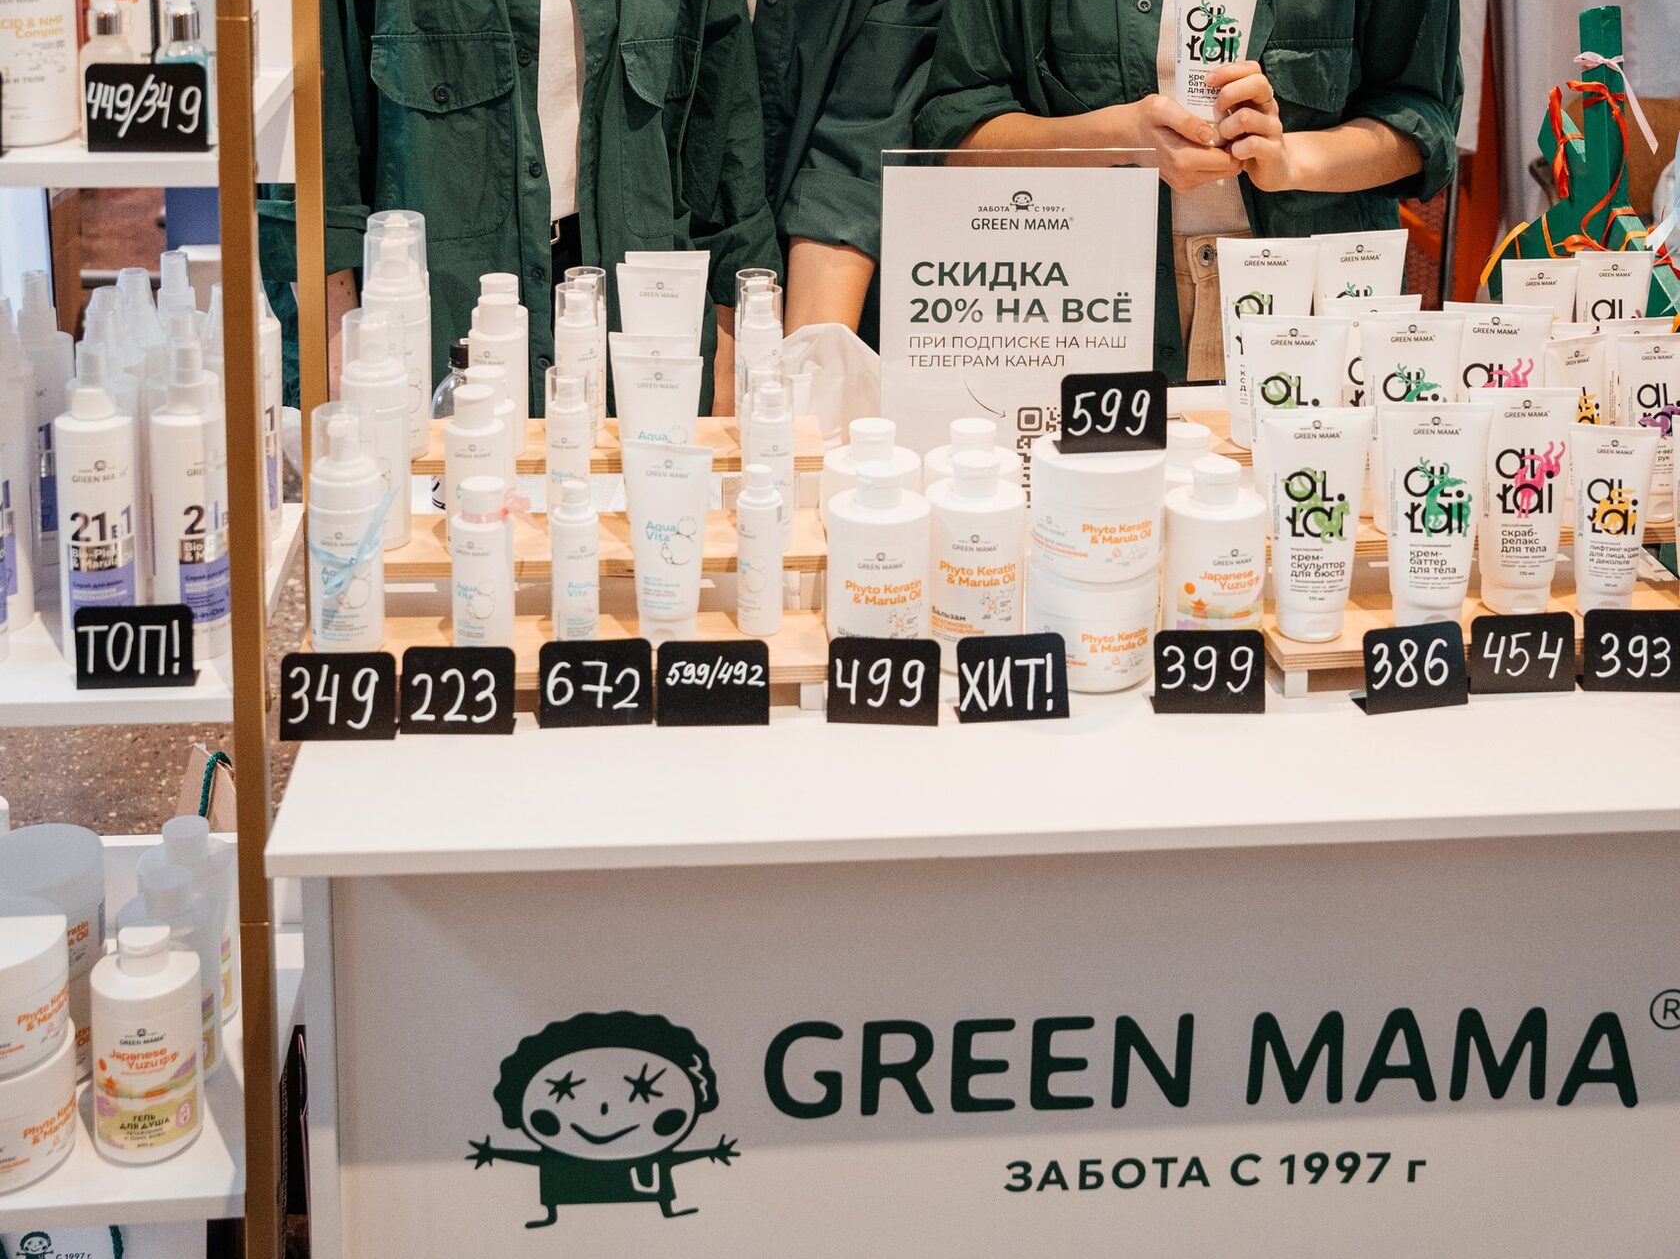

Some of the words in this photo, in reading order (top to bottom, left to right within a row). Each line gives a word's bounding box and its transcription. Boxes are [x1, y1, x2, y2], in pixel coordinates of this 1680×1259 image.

[971, 218, 1019, 230] GREEN
[1024, 218, 1070, 230] MAMA
[1244, 259, 1266, 267] GREEN
[911, 261, 1069, 291] СКИДКА
[910, 298, 983, 323] 20%
[996, 298, 1049, 323] НА
[1062, 291, 1132, 323] ВСЁ
[909, 336, 946, 349] ПРИ
[952, 336, 1050, 351] ПОДПИСКЕ
[1056, 336, 1080, 349] НА
[1085, 335, 1127, 349] НАШ
[1271, 338, 1293, 346] GREEN
[1294, 339, 1316, 347] MAMA
[908, 354, 999, 368] ТЕЛЕГРАМ
[1005, 354, 1066, 368] КАНАЛ
[1068, 388, 1151, 437] 599
[1505, 411, 1527, 419] GREEN
[1527, 410, 1549, 418] MAMA
[1294, 432, 1317, 440] GREEN
[1318, 432, 1341, 440] MAMA
[1413, 428, 1435, 436] GREEN
[1436, 428, 1460, 436] MAMA
[70, 511, 107, 542] 21
[646, 520, 676, 532] Aqua
[1082, 523, 1117, 536] Phyto
[1118, 519, 1153, 534] Keratin
[645, 530, 670, 542] Vita
[1090, 534, 1099, 544] &
[1101, 532, 1138, 544] Marula
[1501, 537, 1539, 546] релакс
[1290, 553, 1324, 561] крем-
[1409, 550, 1443, 558] крем-
[1409, 557, 1447, 566] баттер
[939, 560, 974, 577] Phyto
[977, 561, 1016, 577] Keratin
[1290, 561, 1346, 571] скульптор
[1290, 570, 1311, 578] для
[1314, 569, 1345, 578] бюста
[1409, 566, 1429, 574] для
[1433, 566, 1457, 574] тела
[946, 573, 956, 585] &
[957, 574, 1000, 588] Marula
[1002, 572, 1015, 584] Oil
[1199, 570, 1254, 583] Japanese
[845, 580, 881, 596] Phyto
[884, 579, 922, 594] Keratin
[1219, 580, 1246, 590] Yuzu
[852, 593, 861, 604] &
[865, 594, 907, 606] Marula
[931, 605, 966, 621] Бальзам
[1081, 632, 1115, 645] Phyto
[1117, 626, 1148, 643] Keratin
[77, 619, 181, 676] ТОП!
[1089, 643, 1098, 653] &
[1100, 639, 1134, 652] Marula
[1483, 631, 1563, 679] 454
[1595, 632, 1673, 678] 393
[665, 655, 766, 689] 599/492
[1161, 644, 1254, 693] 399
[1372, 638, 1449, 690] 386
[546, 660, 641, 710] 672
[835, 657, 925, 708] 499
[959, 652, 1053, 712] ХИТ!
[287, 664, 379, 729] 349
[410, 668, 497, 724] 223
[109, 1047, 167, 1061] Japanese
[763, 1012, 1195, 1120] GREEN
[1246, 1006, 1639, 1109] MAMA
[141, 1117, 170, 1130] ДУША
[1003, 1155, 1212, 1193] ЗАБОТА
[1228, 1152, 1262, 1187] С
[1277, 1150, 1392, 1186] 1997
[1406, 1158, 1428, 1183] г
